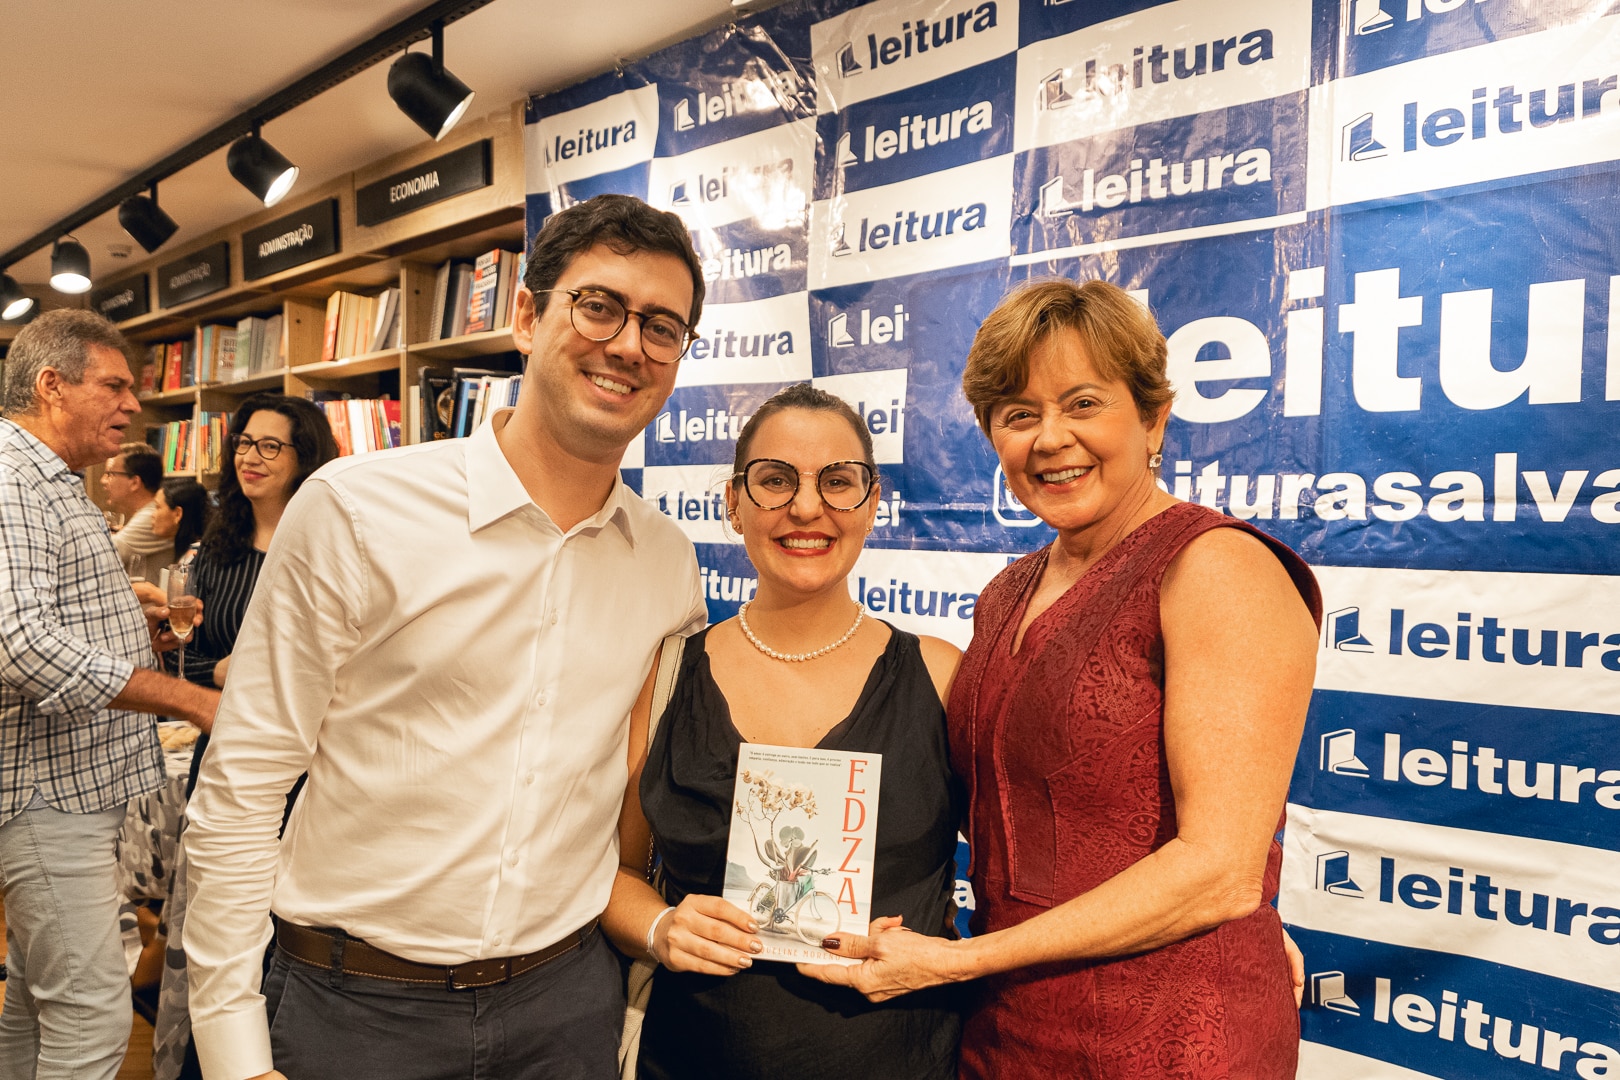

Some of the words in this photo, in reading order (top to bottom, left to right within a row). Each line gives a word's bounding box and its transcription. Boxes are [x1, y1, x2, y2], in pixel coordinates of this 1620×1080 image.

[868, 1, 998, 70] leitura
[555, 120, 636, 162] leitura
[864, 100, 993, 163] leitura
[1403, 74, 1620, 153] leitur
[389, 171, 440, 204] ECONOMIA
[1082, 147, 1272, 212] leitura
[258, 223, 314, 258] ADMINISTRAÇÃO
[858, 202, 987, 253] leitura
[699, 243, 792, 283] eitura
[861, 304, 910, 346] lei
[1126, 266, 1620, 424] eitu
[678, 408, 751, 442] leitu
[837, 759, 869, 915] EDZA
[1379, 856, 1620, 945] leitura
[1373, 976, 1620, 1080] leitura
